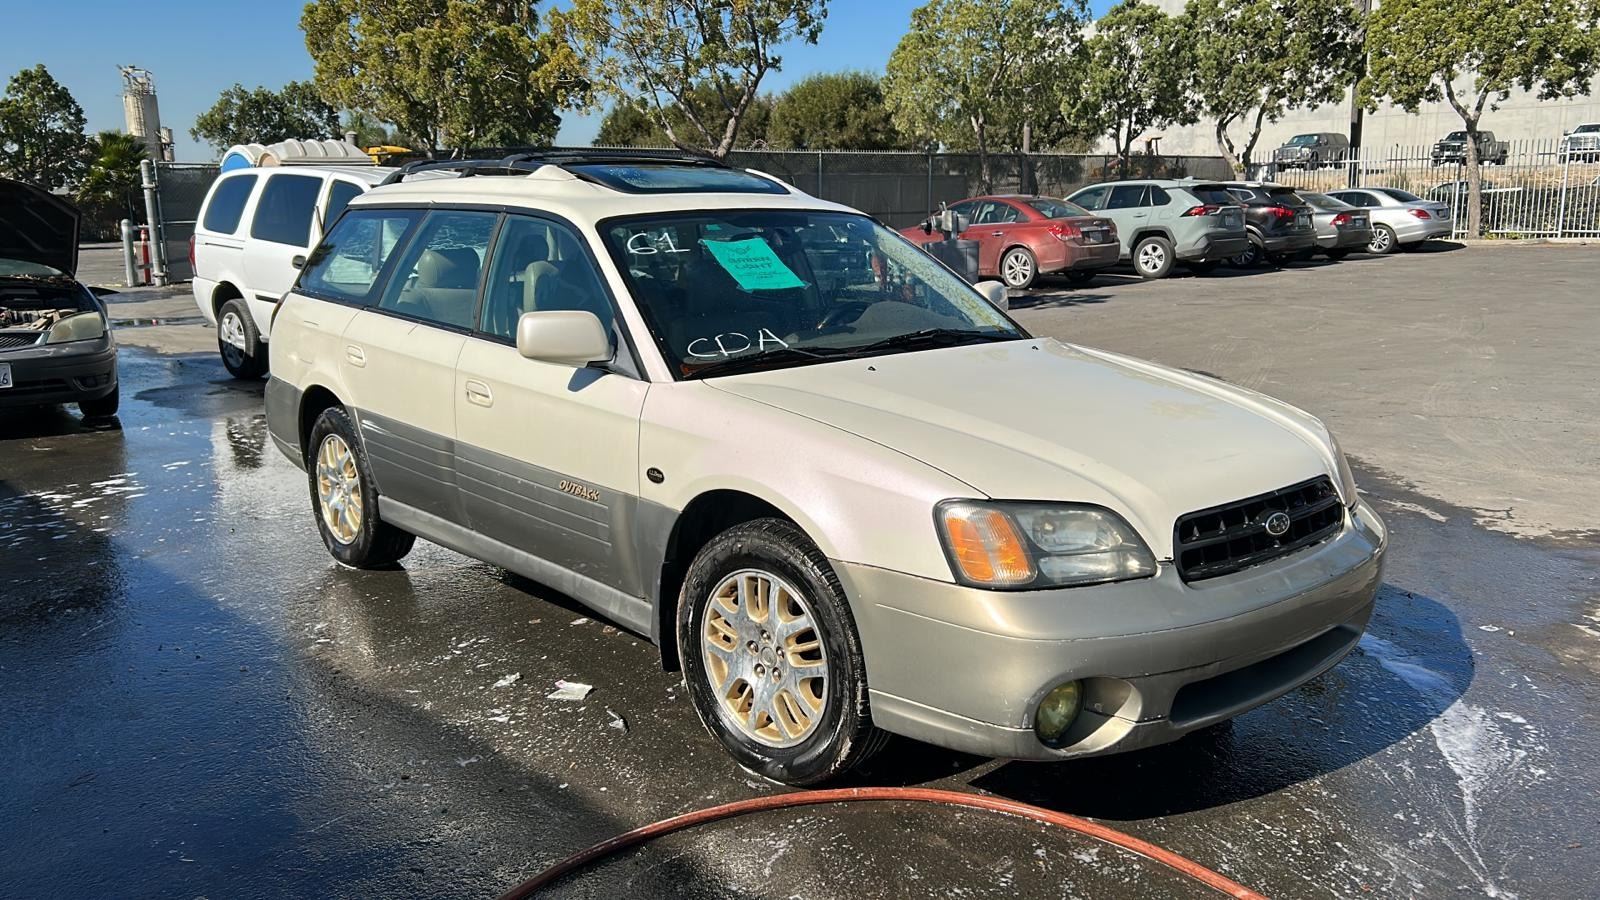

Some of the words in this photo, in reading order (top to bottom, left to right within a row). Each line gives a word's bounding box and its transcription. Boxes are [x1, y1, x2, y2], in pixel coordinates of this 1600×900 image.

[627, 233, 691, 254] 61
[687, 328, 789, 357] CDA
[0, 372, 8, 384] 6
[559, 479, 600, 501] OUTBACK
